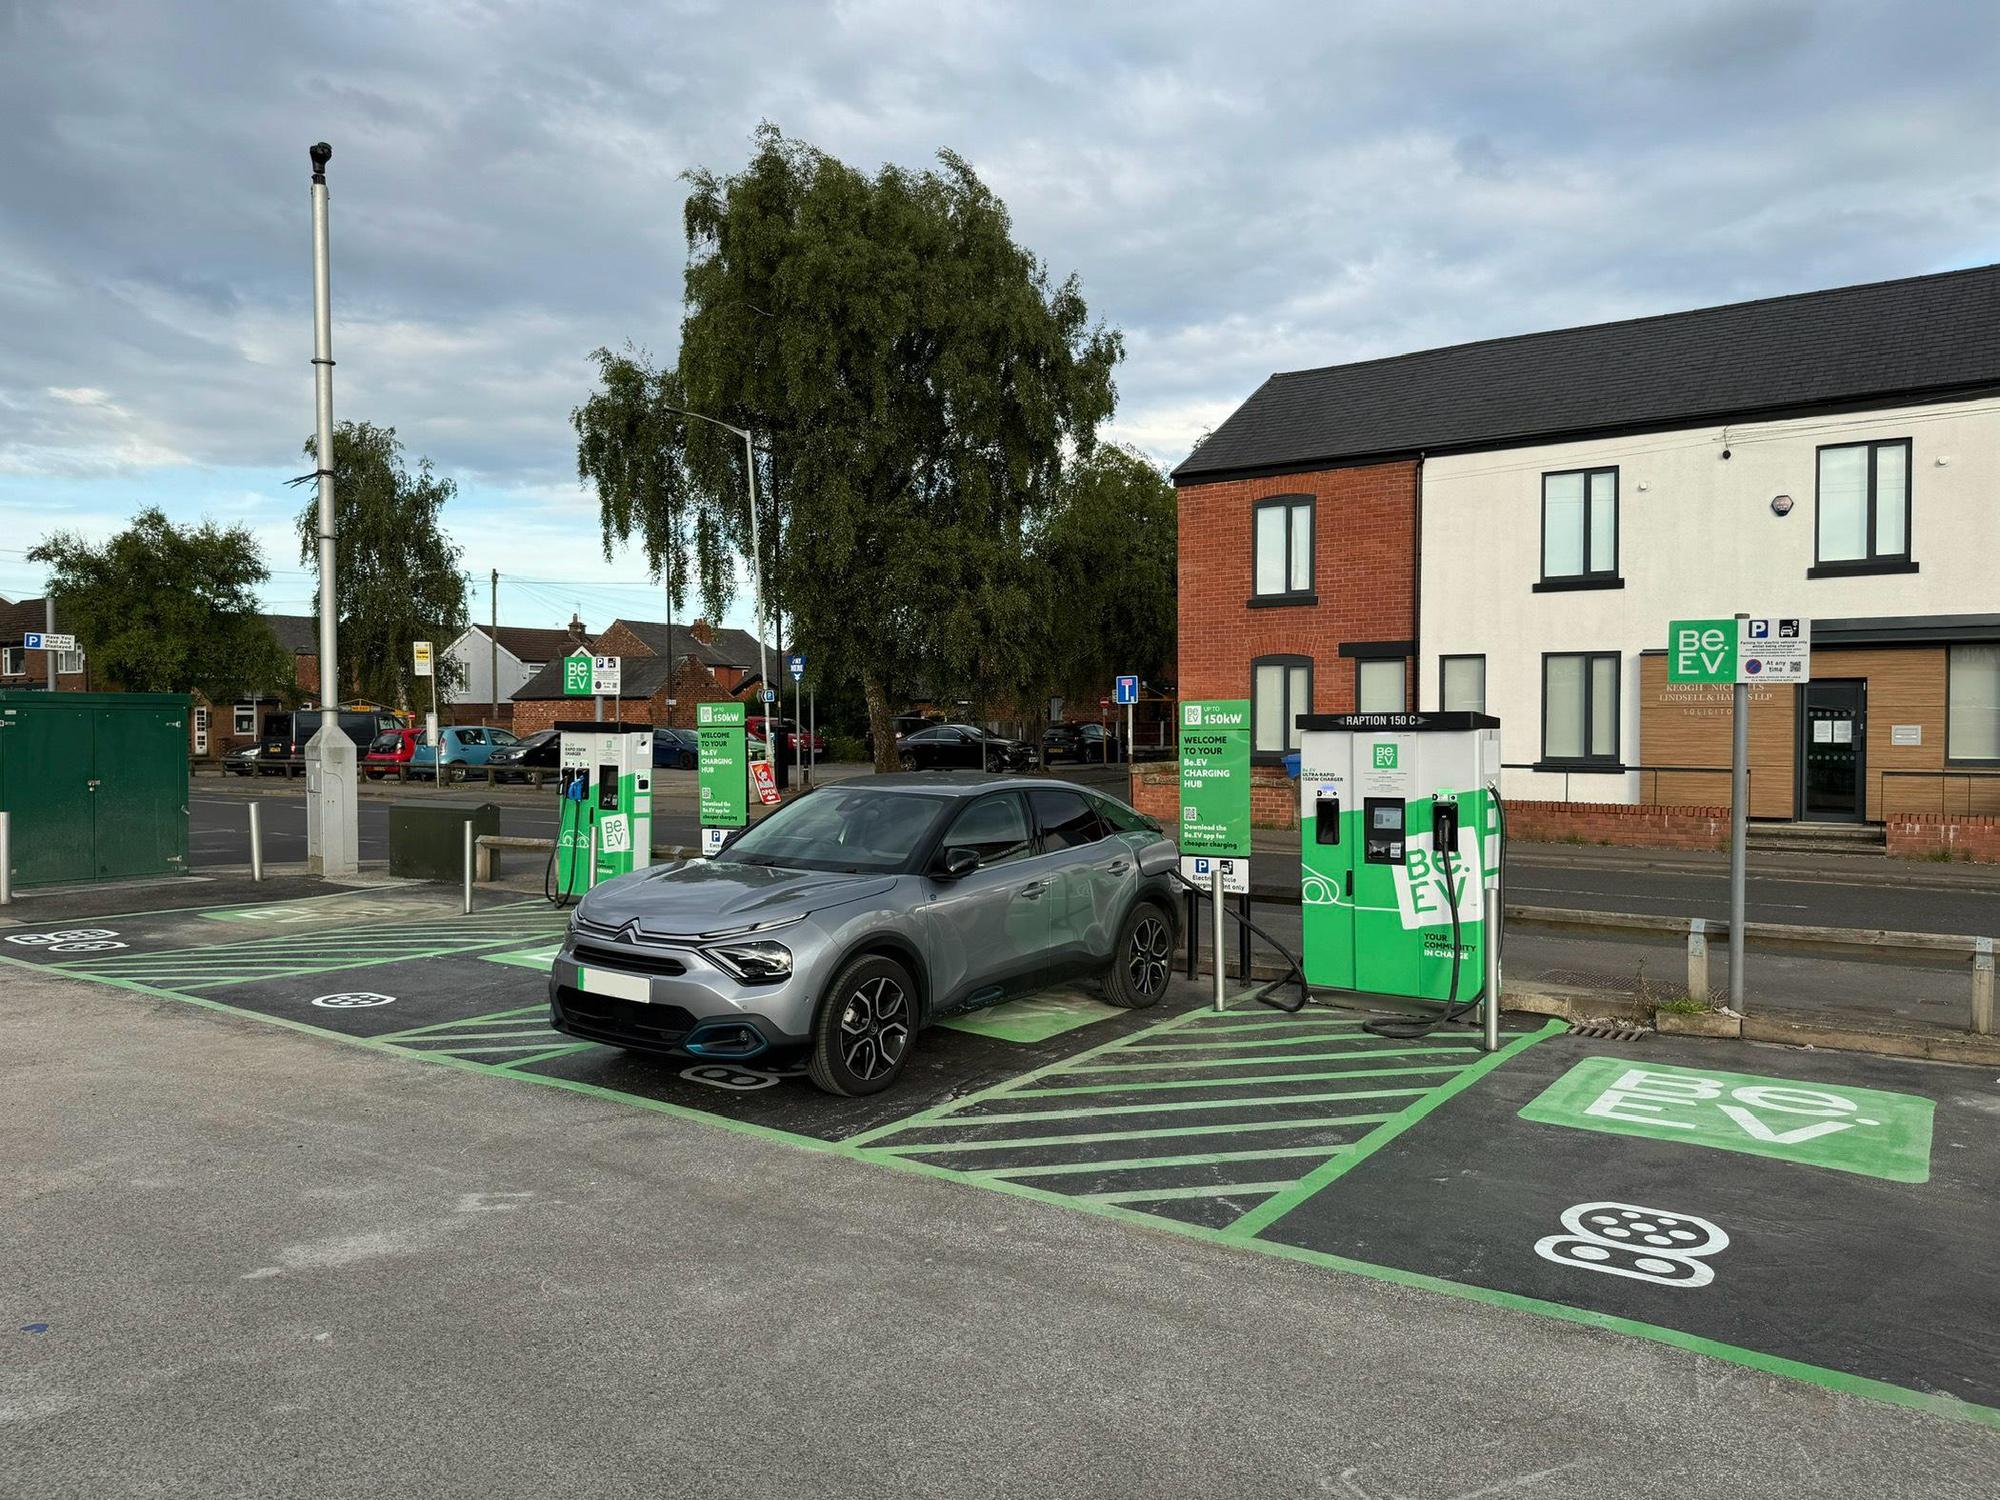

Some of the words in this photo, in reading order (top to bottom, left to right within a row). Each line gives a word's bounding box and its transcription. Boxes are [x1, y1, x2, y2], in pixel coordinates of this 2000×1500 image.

[1751, 621, 1766, 637] P
[29, 636, 38, 646] P
[1679, 629, 1729, 651] Be.
[1678, 652, 1725, 674] EV
[568, 676, 587, 689] EV
[713, 713, 739, 722] 150kW
[1204, 714, 1242, 724] 150kW
[1346, 715, 1387, 726] RAPTION
[1389, 715, 1407, 725] 150
[1409, 715, 1416, 725] C
[1184, 736, 1227, 744] WELCOME
[1184, 747, 1196, 755] TO
[1198, 747, 1223, 755] YOUR
[1376, 747, 1395, 756] Be.
[1184, 758, 1208, 767] Be.EV
[1376, 756, 1394, 766] EV
[1184, 769, 1230, 778] CHARGING
[1184, 780, 1203, 788] HUB
[1184, 823, 1215, 831] Download
[606, 833, 624, 847] EV
[1203, 833, 1215, 841] app
[1184, 840, 1208, 848] cheaper
[1209, 841, 1238, 850] charging
[1198, 861, 1207, 872] P
[1410, 876, 1467, 914] EV
[1424, 932, 1447, 941] YOUR
[1424, 942, 1477, 952] COMMUITY
[1424, 949, 1433, 957] IN
[1434, 950, 1469, 960] CHAGE
[1584, 1088, 1857, 1144] EV
